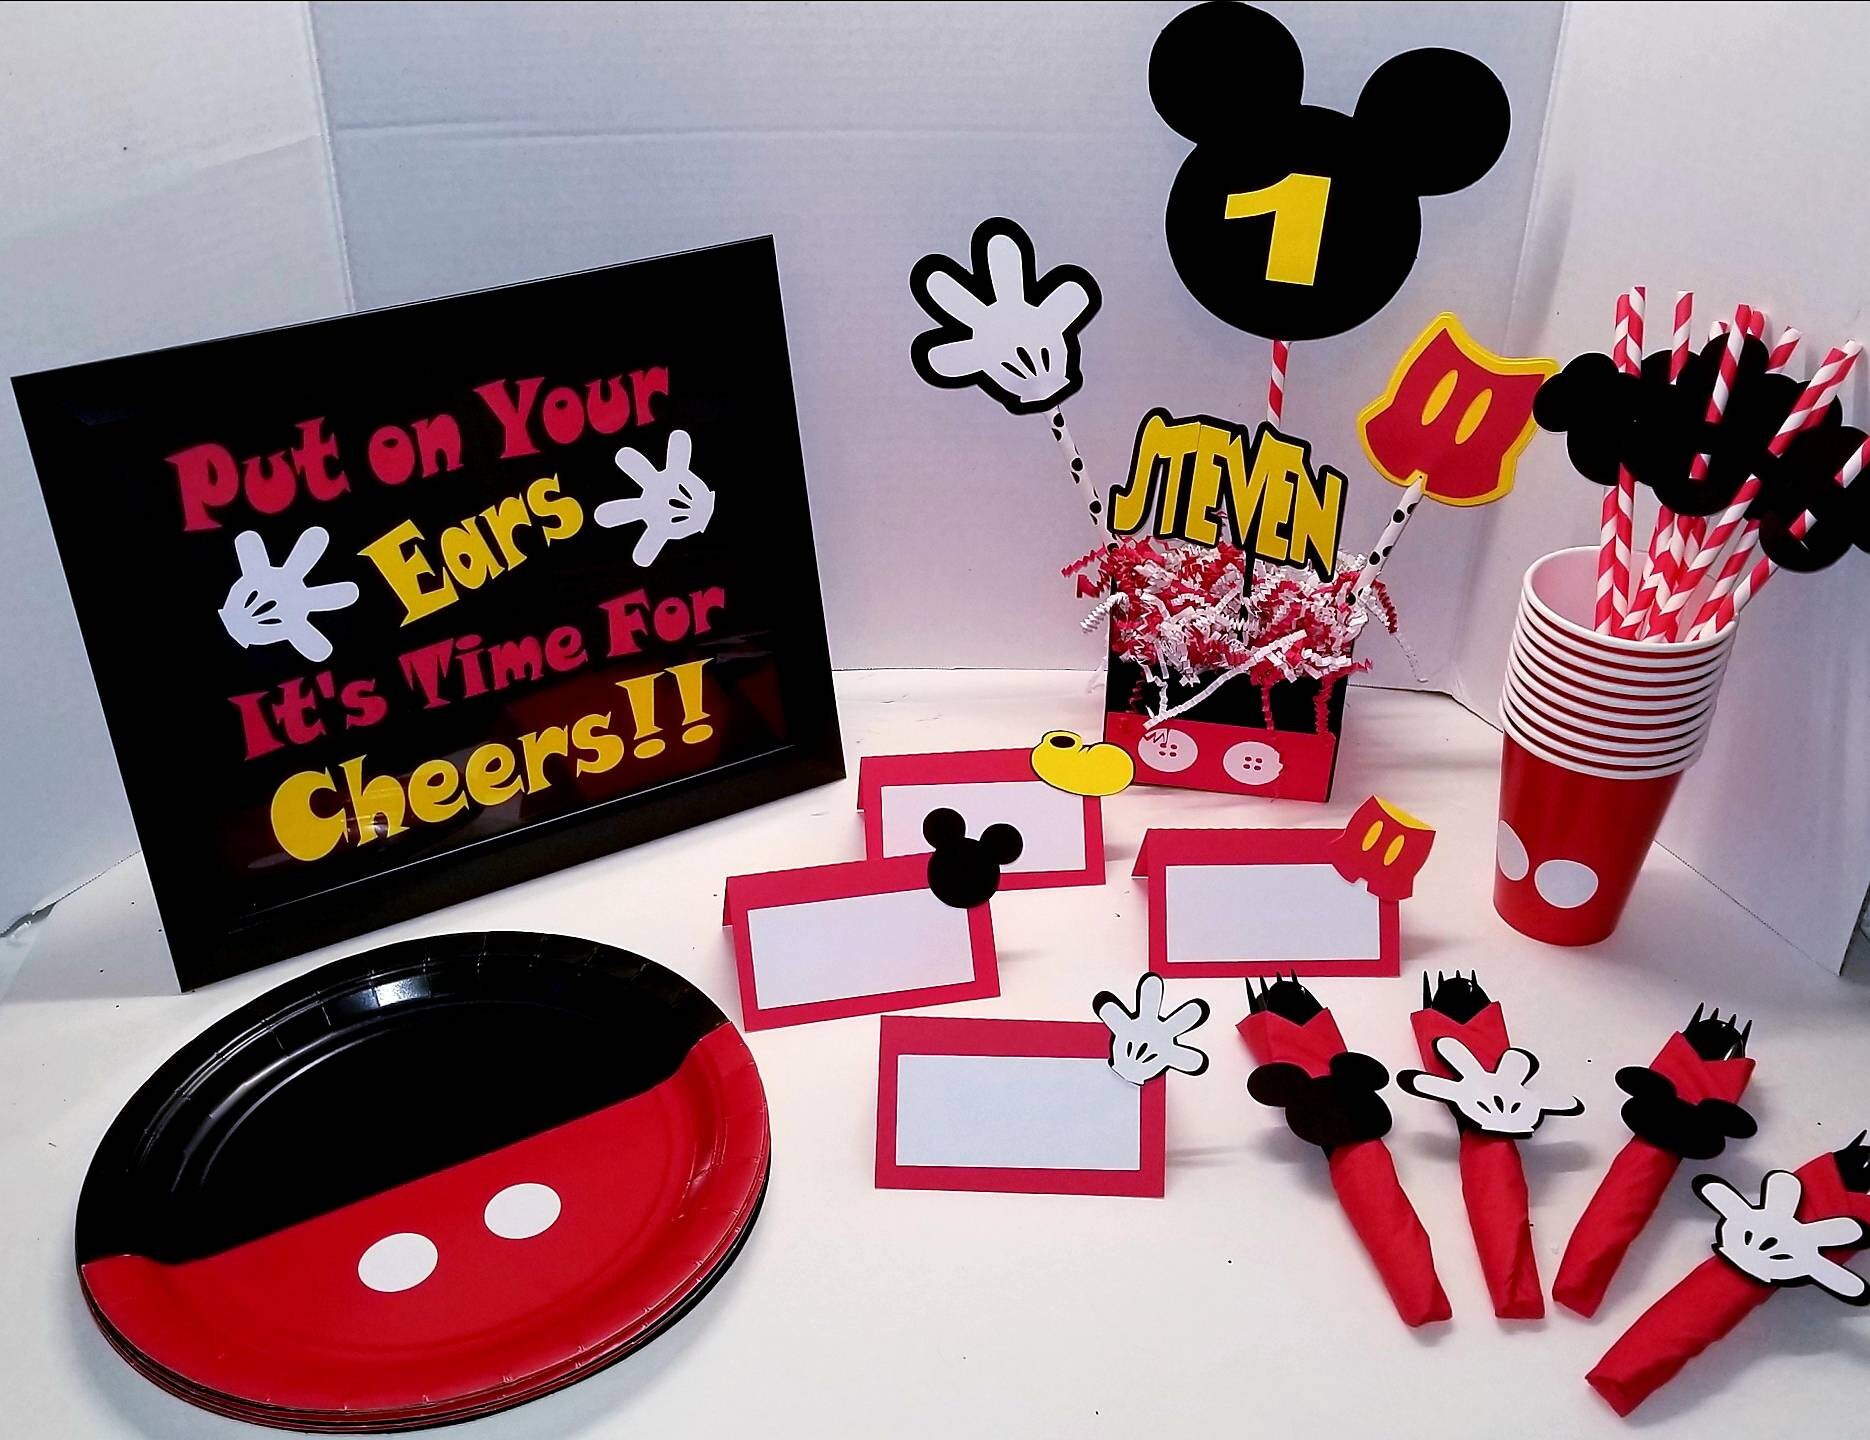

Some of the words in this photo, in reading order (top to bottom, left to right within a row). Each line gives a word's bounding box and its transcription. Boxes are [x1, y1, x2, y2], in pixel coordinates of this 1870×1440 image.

[1224, 173, 1332, 287] 1
[165, 416, 350, 532] Put
[368, 410, 464, 486] on
[473, 366, 671, 459] Your
[1112, 415, 1344, 577] STEVEN
[357, 472, 585, 628] Ears
[228, 671, 388, 760] It's
[401, 625, 587, 709] Time
[599, 586, 726, 657] For
[270, 657, 716, 862] Cheers!!
